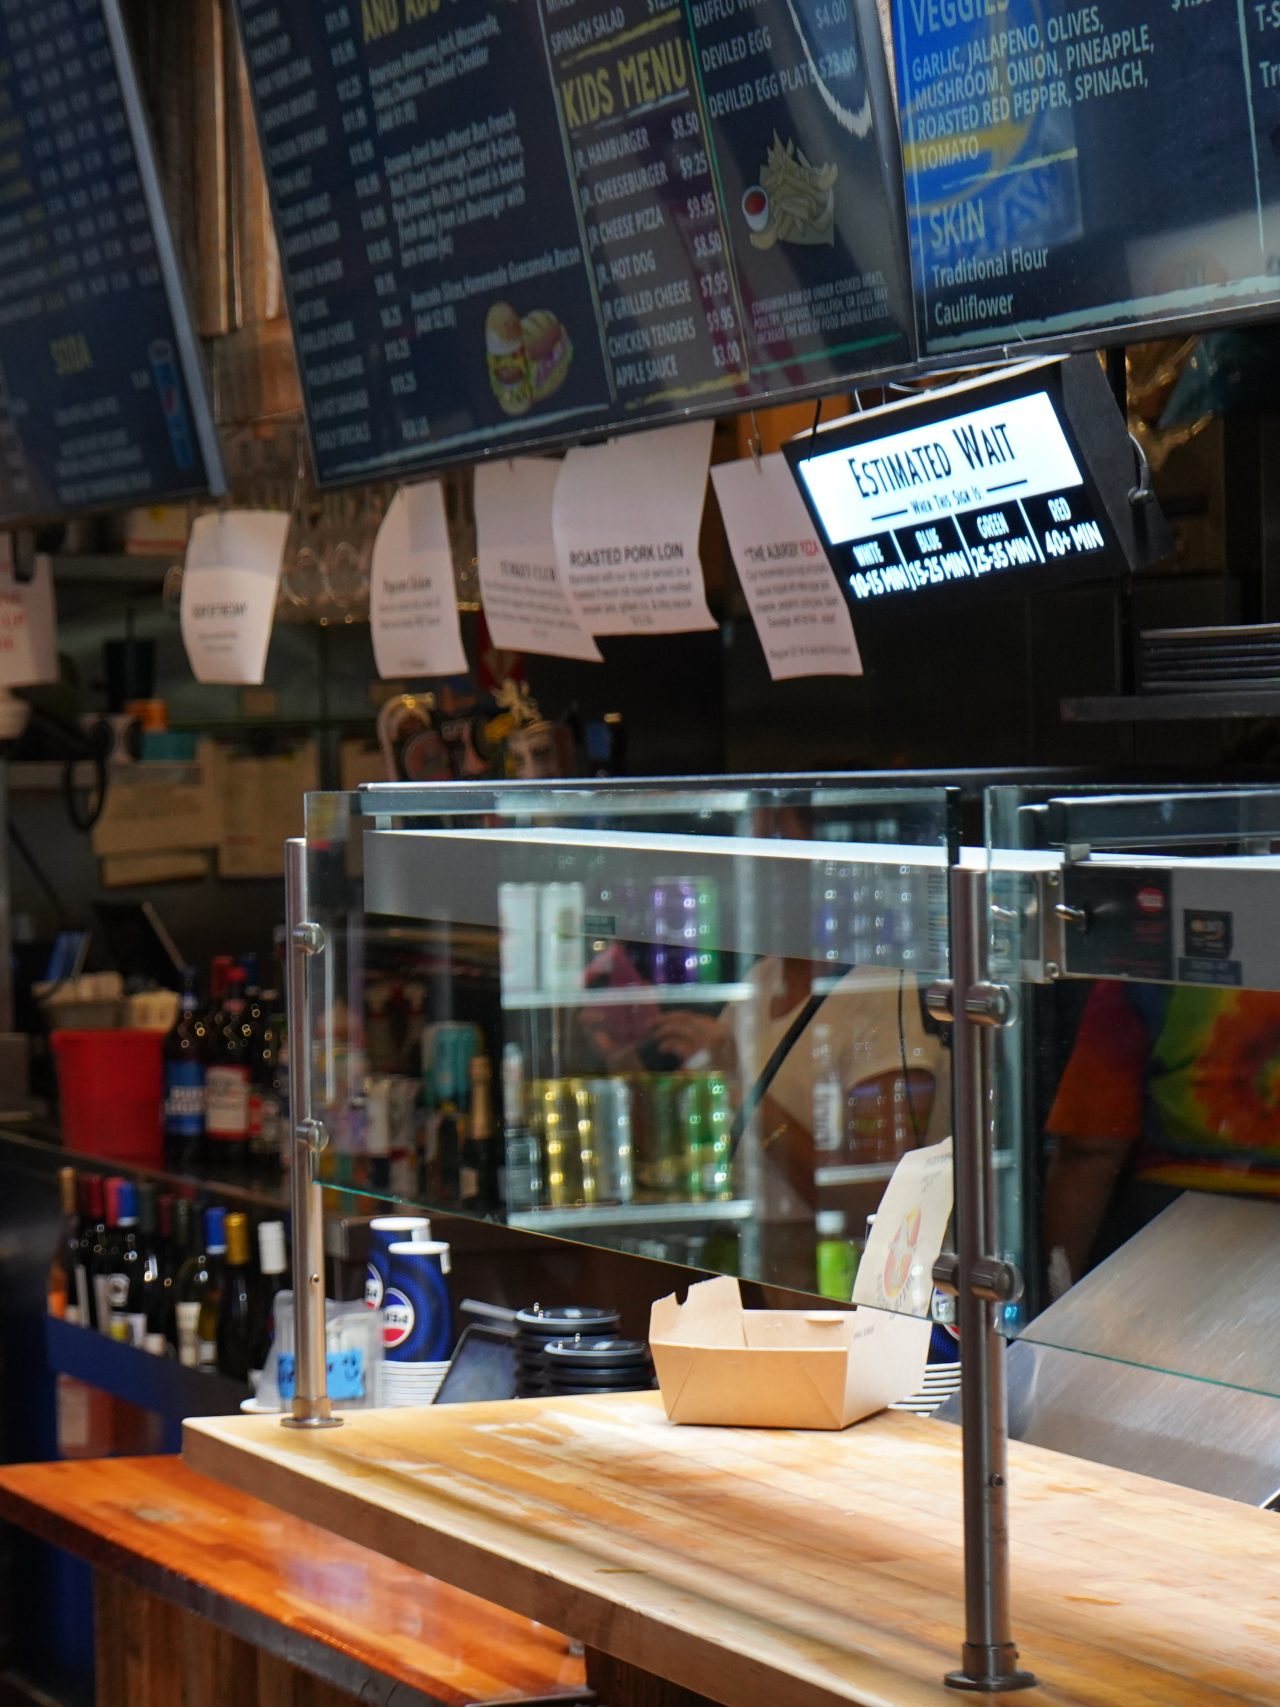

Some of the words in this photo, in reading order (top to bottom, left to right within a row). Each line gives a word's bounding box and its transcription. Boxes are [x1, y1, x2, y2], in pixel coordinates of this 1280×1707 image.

[550, 20, 593, 56] SPINACH
[592, 7, 625, 38] SALAD
[701, 35, 747, 73] DEVILED
[747, 25, 772, 55] EGG
[815, 1, 848, 29] $4.00
[909, 0, 1009, 37] VEGG
[912, 46, 966, 82] GARLIC,
[967, 23, 1045, 74] JALAPENO,
[1047, 6, 1104, 44] OLIVES,
[561, 66, 614, 129] KIDS
[617, 37, 686, 109] MENU
[914, 66, 1005, 113] MUSHROOM,
[1007, 49, 1063, 88] ONION,
[1066, 24, 1155, 72] PINEAPPLE,
[708, 81, 754, 119] DEVILED
[754, 72, 780, 102] EGG
[917, 105, 980, 142] ROASTED
[983, 97, 1011, 125] RED
[1013, 80, 1073, 118] PEPPER,
[1075, 59, 1149, 102] SPINACH,
[587, 126, 650, 168] HAMBURGER
[671, 111, 700, 140] $8.50
[919, 135, 980, 172] TOMATO
[593, 160, 669, 205] CHEESEBURGER
[679, 151, 708, 180] $9.25
[598, 211, 635, 245] CHEESE
[634, 205, 666, 234] PIZZA
[686, 191, 716, 220] $9.95
[929, 197, 986, 249] SKIN
[610, 255, 634, 282] HOT
[632, 249, 657, 276] DOG
[693, 229, 722, 258] $8.50
[1011, 246, 1049, 273] Flour
[613, 289, 654, 321] GRILLED
[653, 279, 692, 310] CHEESE
[700, 270, 729, 299] $7.95
[934, 293, 1014, 326] Cauliflower
[607, 327, 651, 358] CHICKEN
[649, 316, 697, 349] TENDERS
[706, 306, 735, 334] $9.95
[615, 360, 648, 388] APPLE
[646, 353, 679, 382] SAUCE
[712, 339, 741, 368] $3.00
[847, 441, 952, 498] ESTIMATED
[952, 423, 1017, 471] WAIT
[910, 499, 933, 515] WHEN
[932, 494, 952, 511] THIS
[951, 489, 972, 506] SIGN
[976, 511, 1010, 539] GREEN
[1047, 496, 1071, 522] RED
[569, 547, 622, 569] ROASTED
[623, 544, 655, 563] PORK
[657, 541, 684, 560] LOIN
[852, 541, 884, 567] WHITE
[915, 527, 942, 554] BLUE
[971, 541, 1009, 574] 25-35
[1004, 535, 1037, 566] MIN
[1045, 529, 1071, 556] 40+
[1069, 520, 1104, 552] MIN
[849, 569, 885, 599] 10-15
[879, 562, 910, 593] MIN
[909, 556, 944, 586] 15-25
[939, 550, 971, 580] MIN
